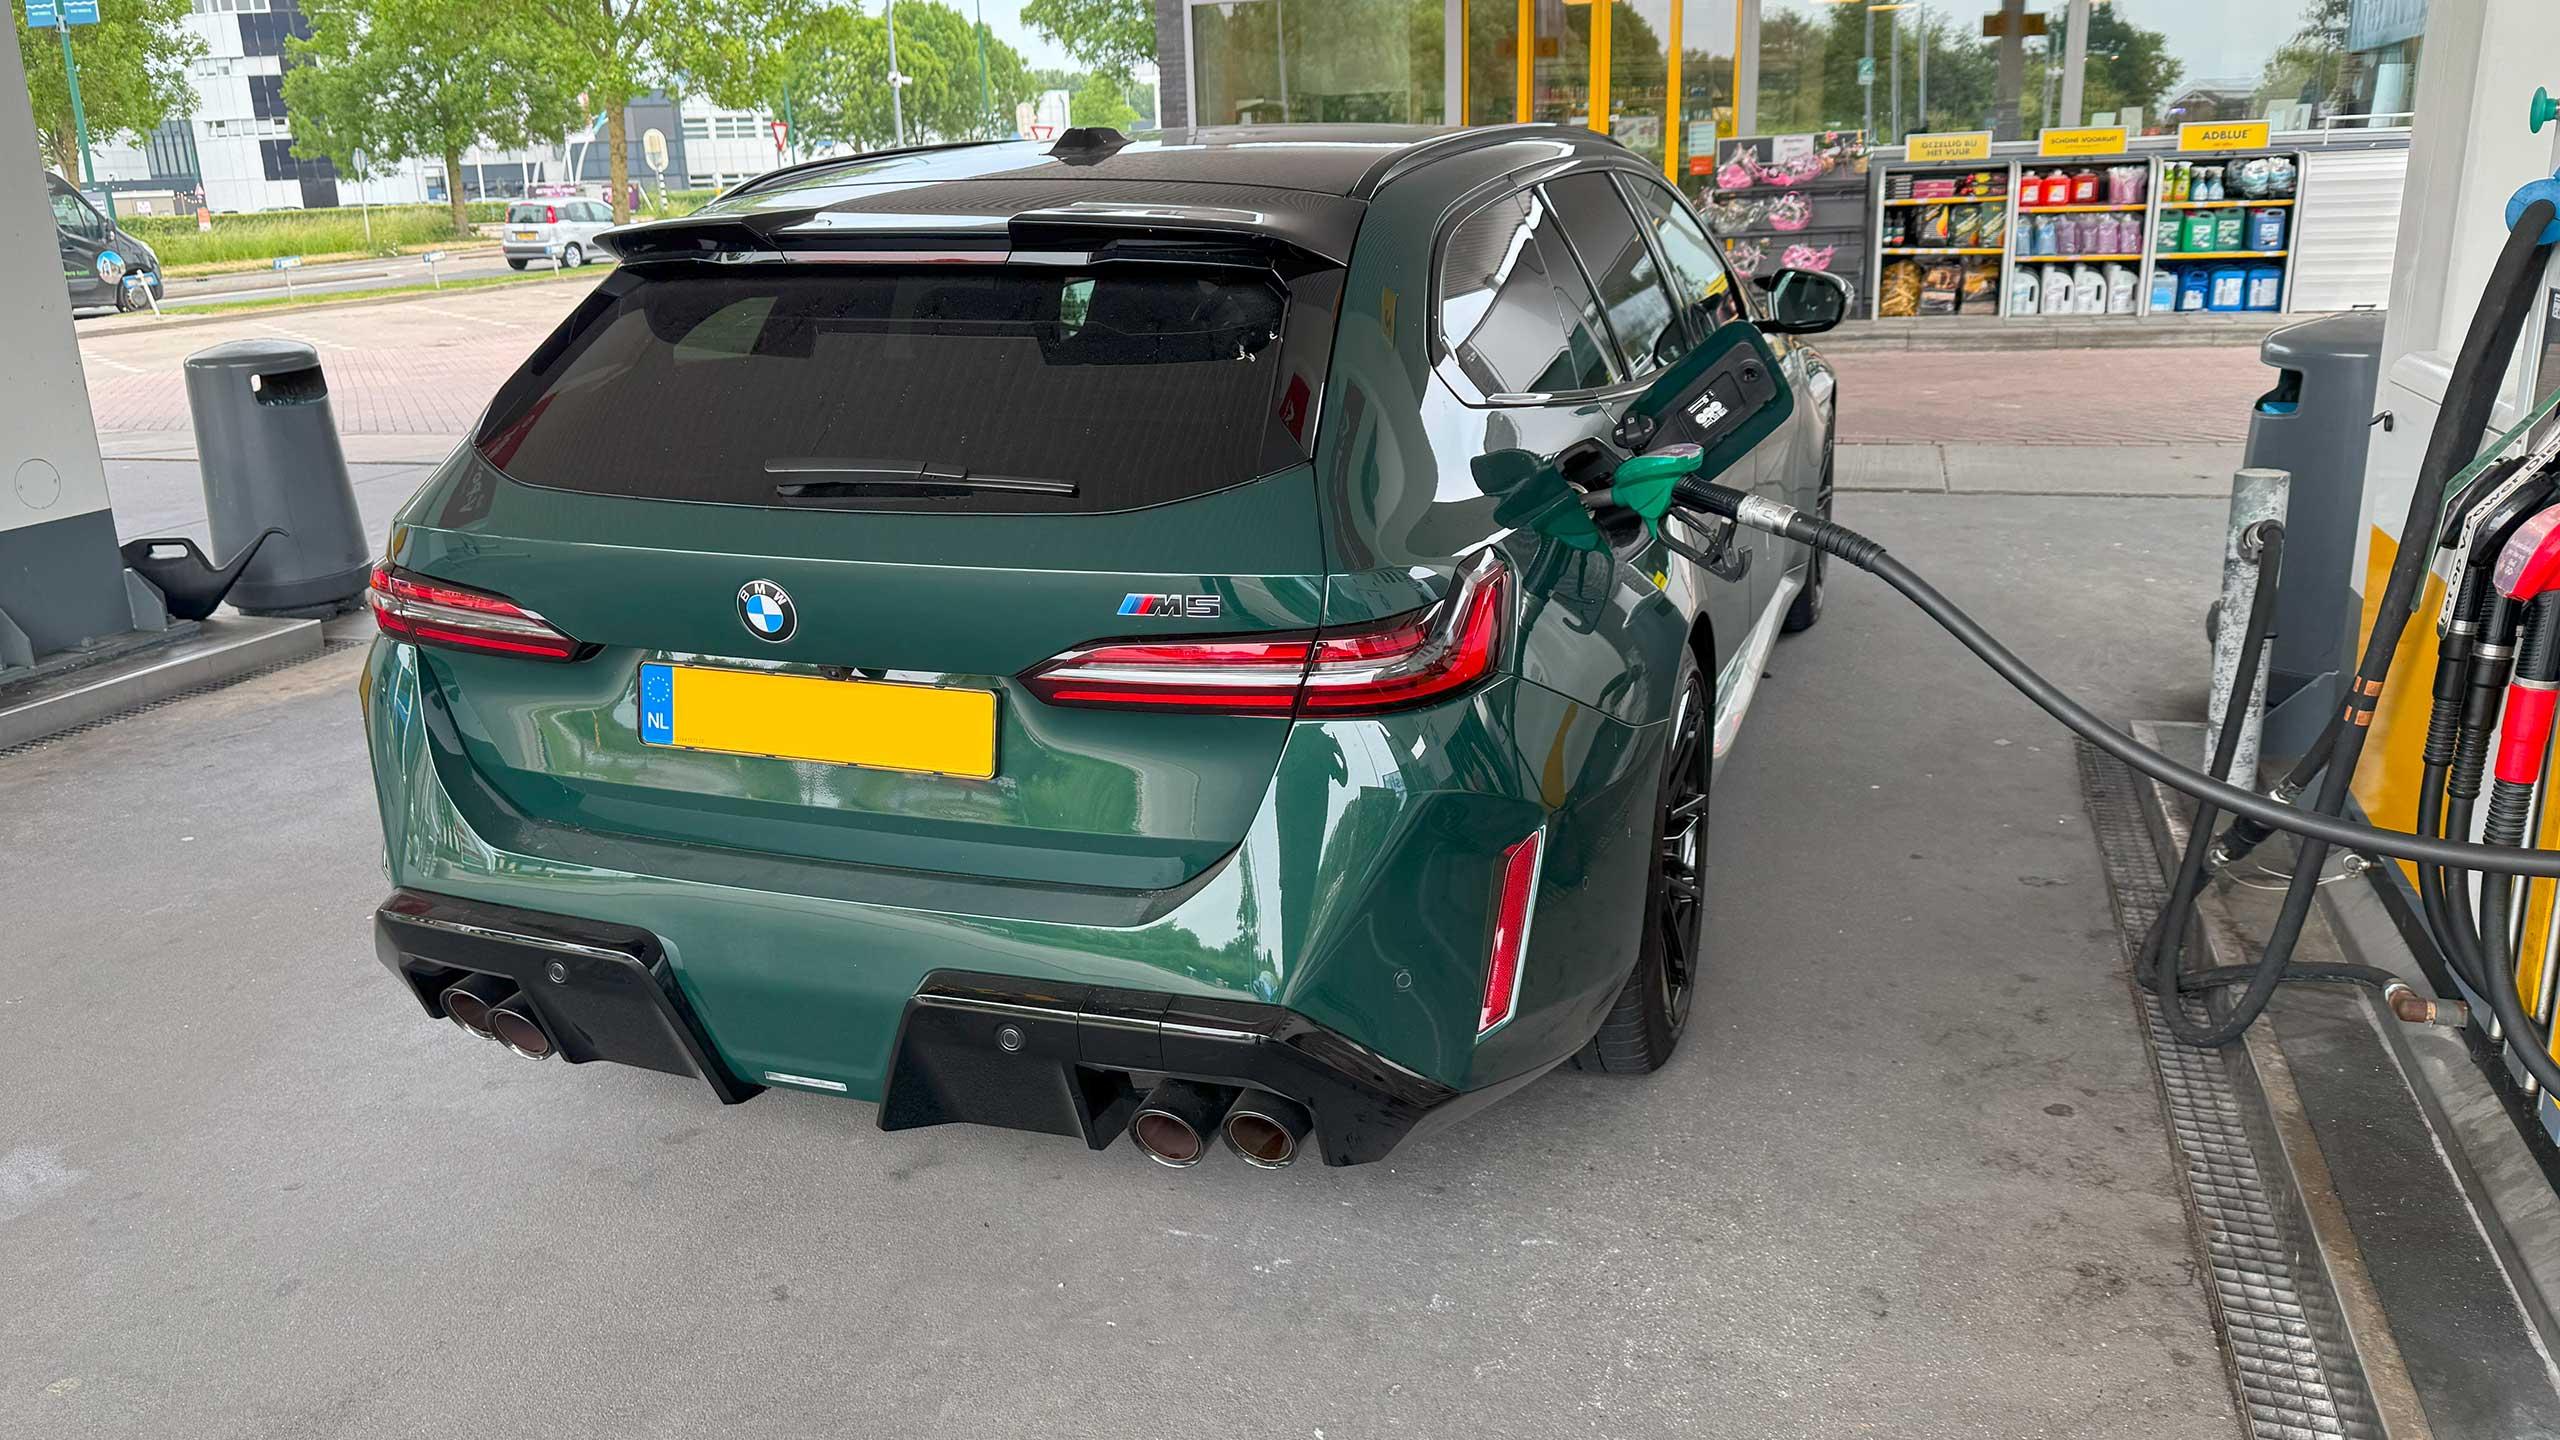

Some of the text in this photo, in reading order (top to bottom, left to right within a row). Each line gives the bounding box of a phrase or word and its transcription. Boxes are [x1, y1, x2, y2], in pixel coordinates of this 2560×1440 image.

[2201, 129, 2249, 140] ADBLUE
[2452, 558, 2462, 585] op
[2525, 437, 2560, 471] Die
[740, 583, 787, 606] BMW
[1124, 592, 1221, 618] M5
[647, 710, 671, 731] NL
